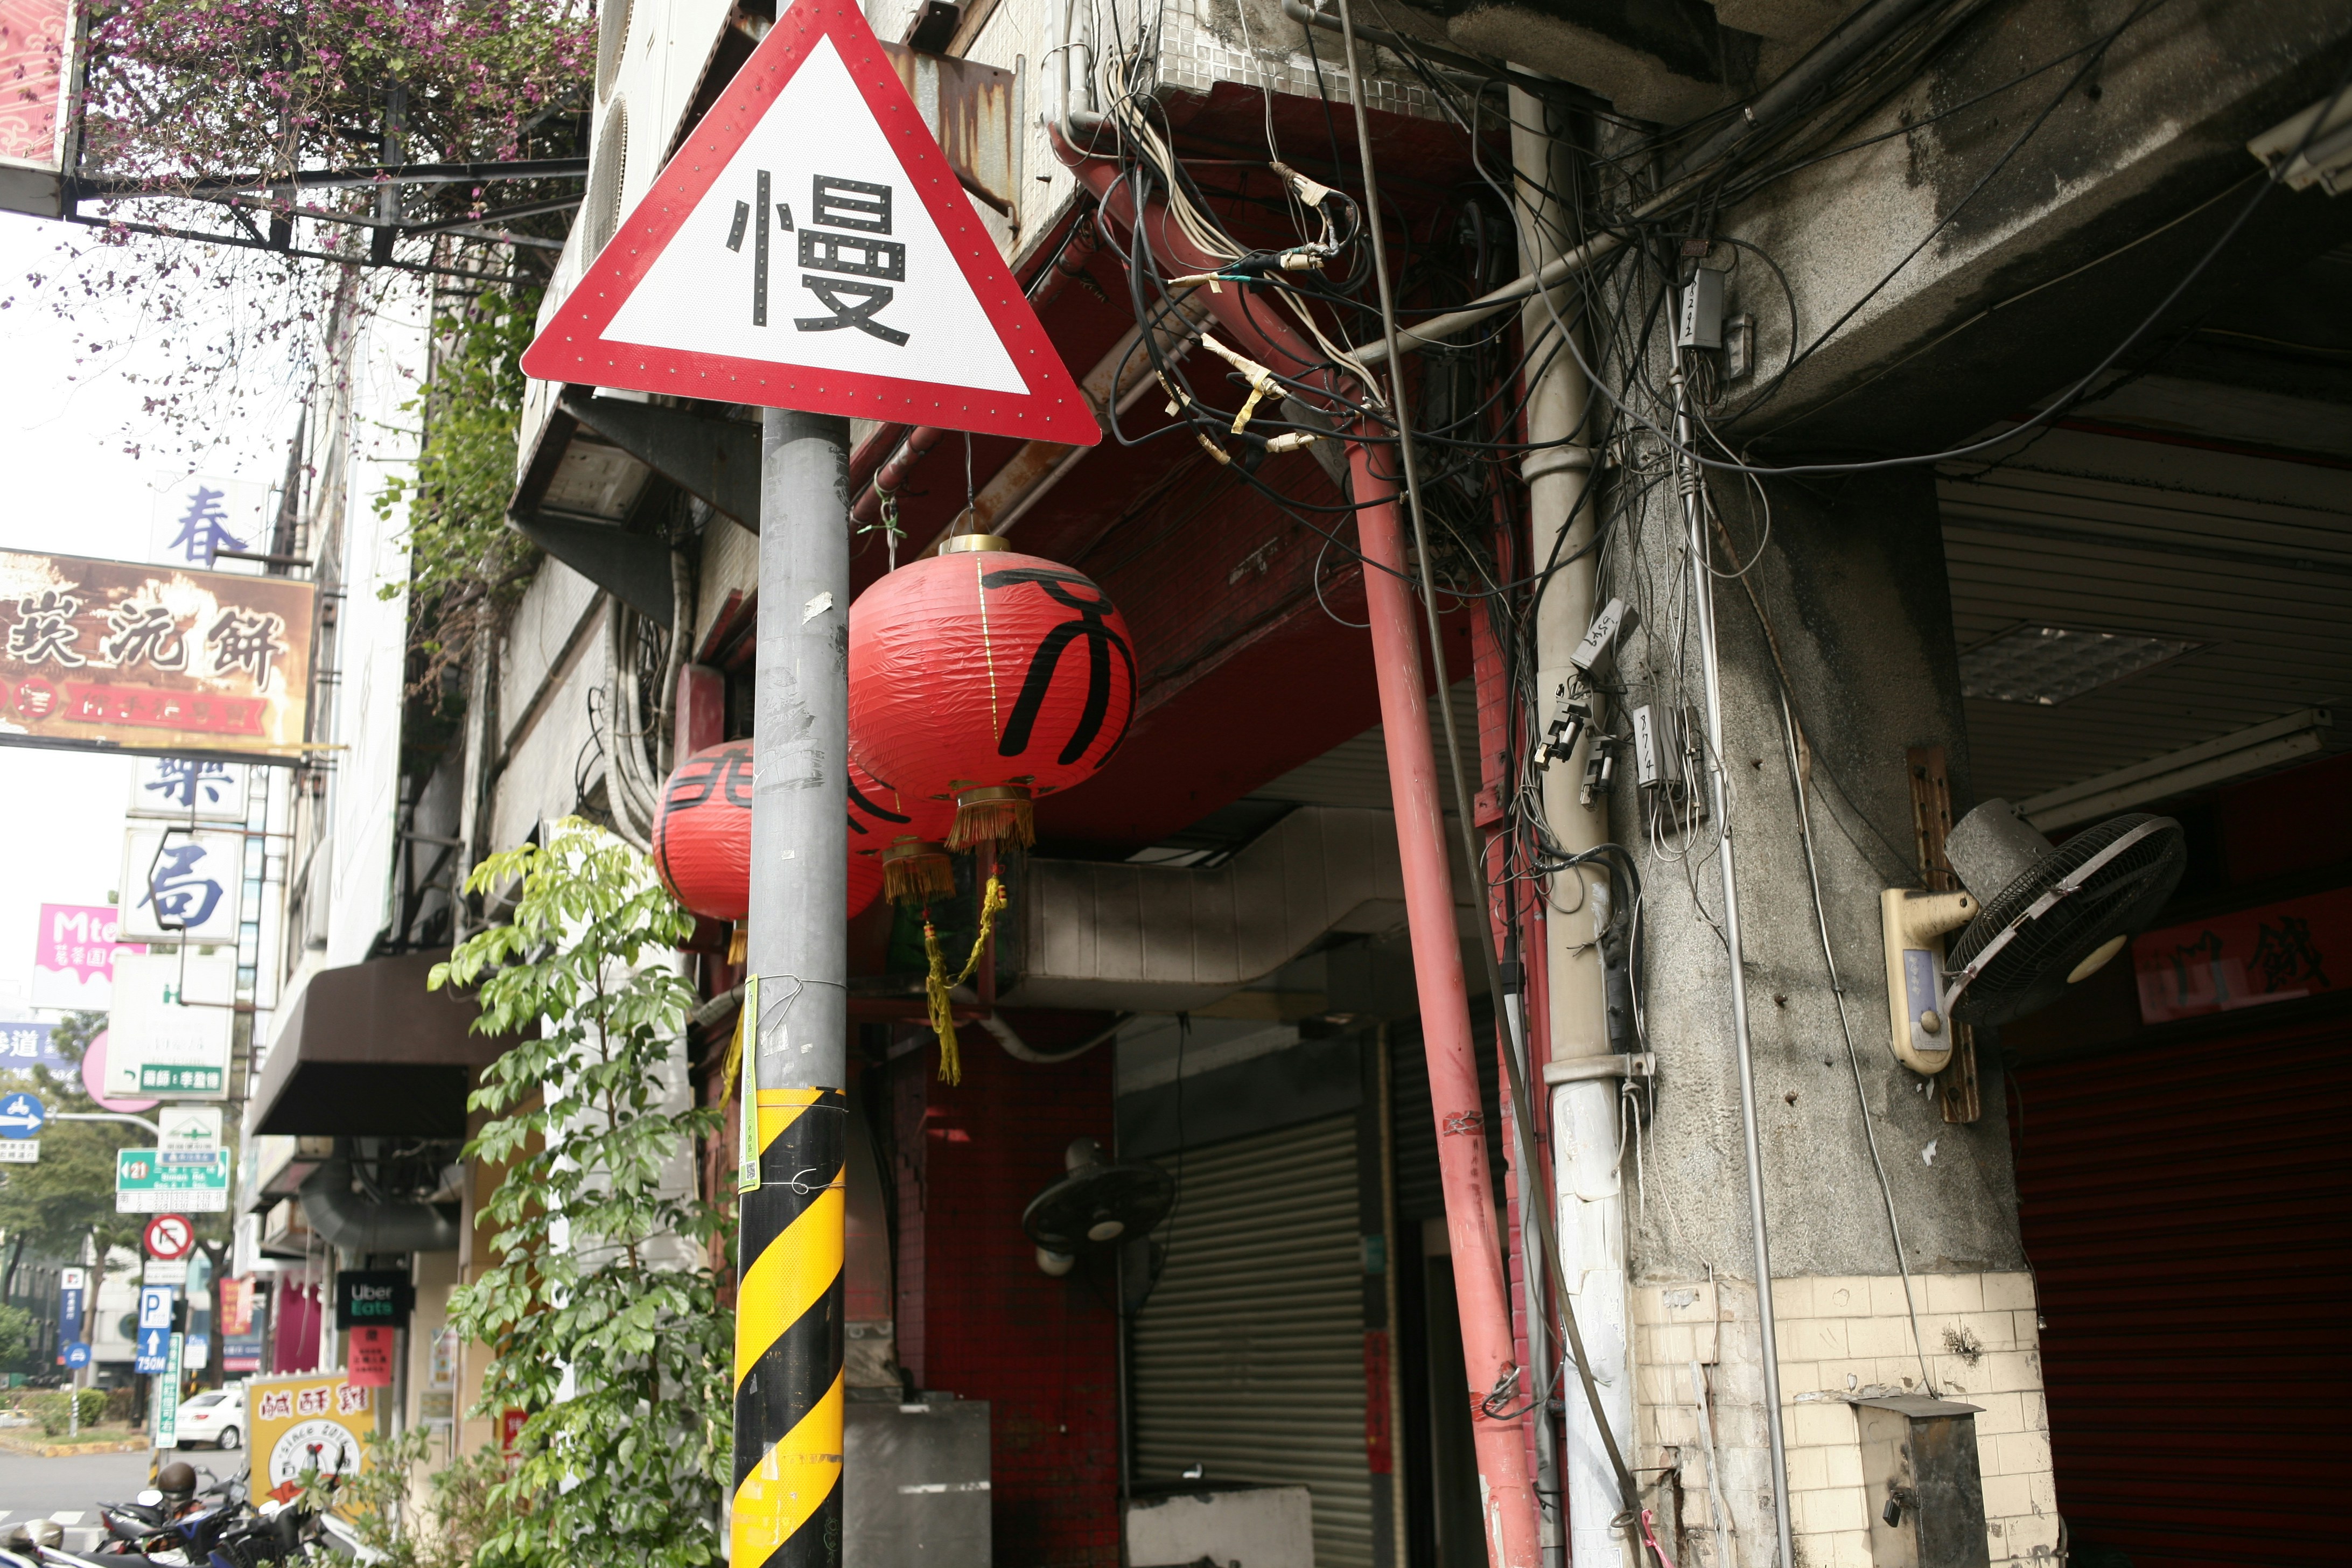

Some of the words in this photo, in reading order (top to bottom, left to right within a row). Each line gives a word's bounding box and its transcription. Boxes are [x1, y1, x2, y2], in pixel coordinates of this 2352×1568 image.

[726, 169, 910, 347] 慢
[1685, 279, 1697, 337] 8292
[169, 484, 249, 566] 春
[1640, 715, 1655, 780] 8714
[146, 1294, 160, 1322] P
[351, 1284, 393, 1299] Uber
[351, 1299, 393, 1317] Eats
[138, 1356, 166, 1371] 750M
[261, 1385, 369, 1418] 鹹酥雞
